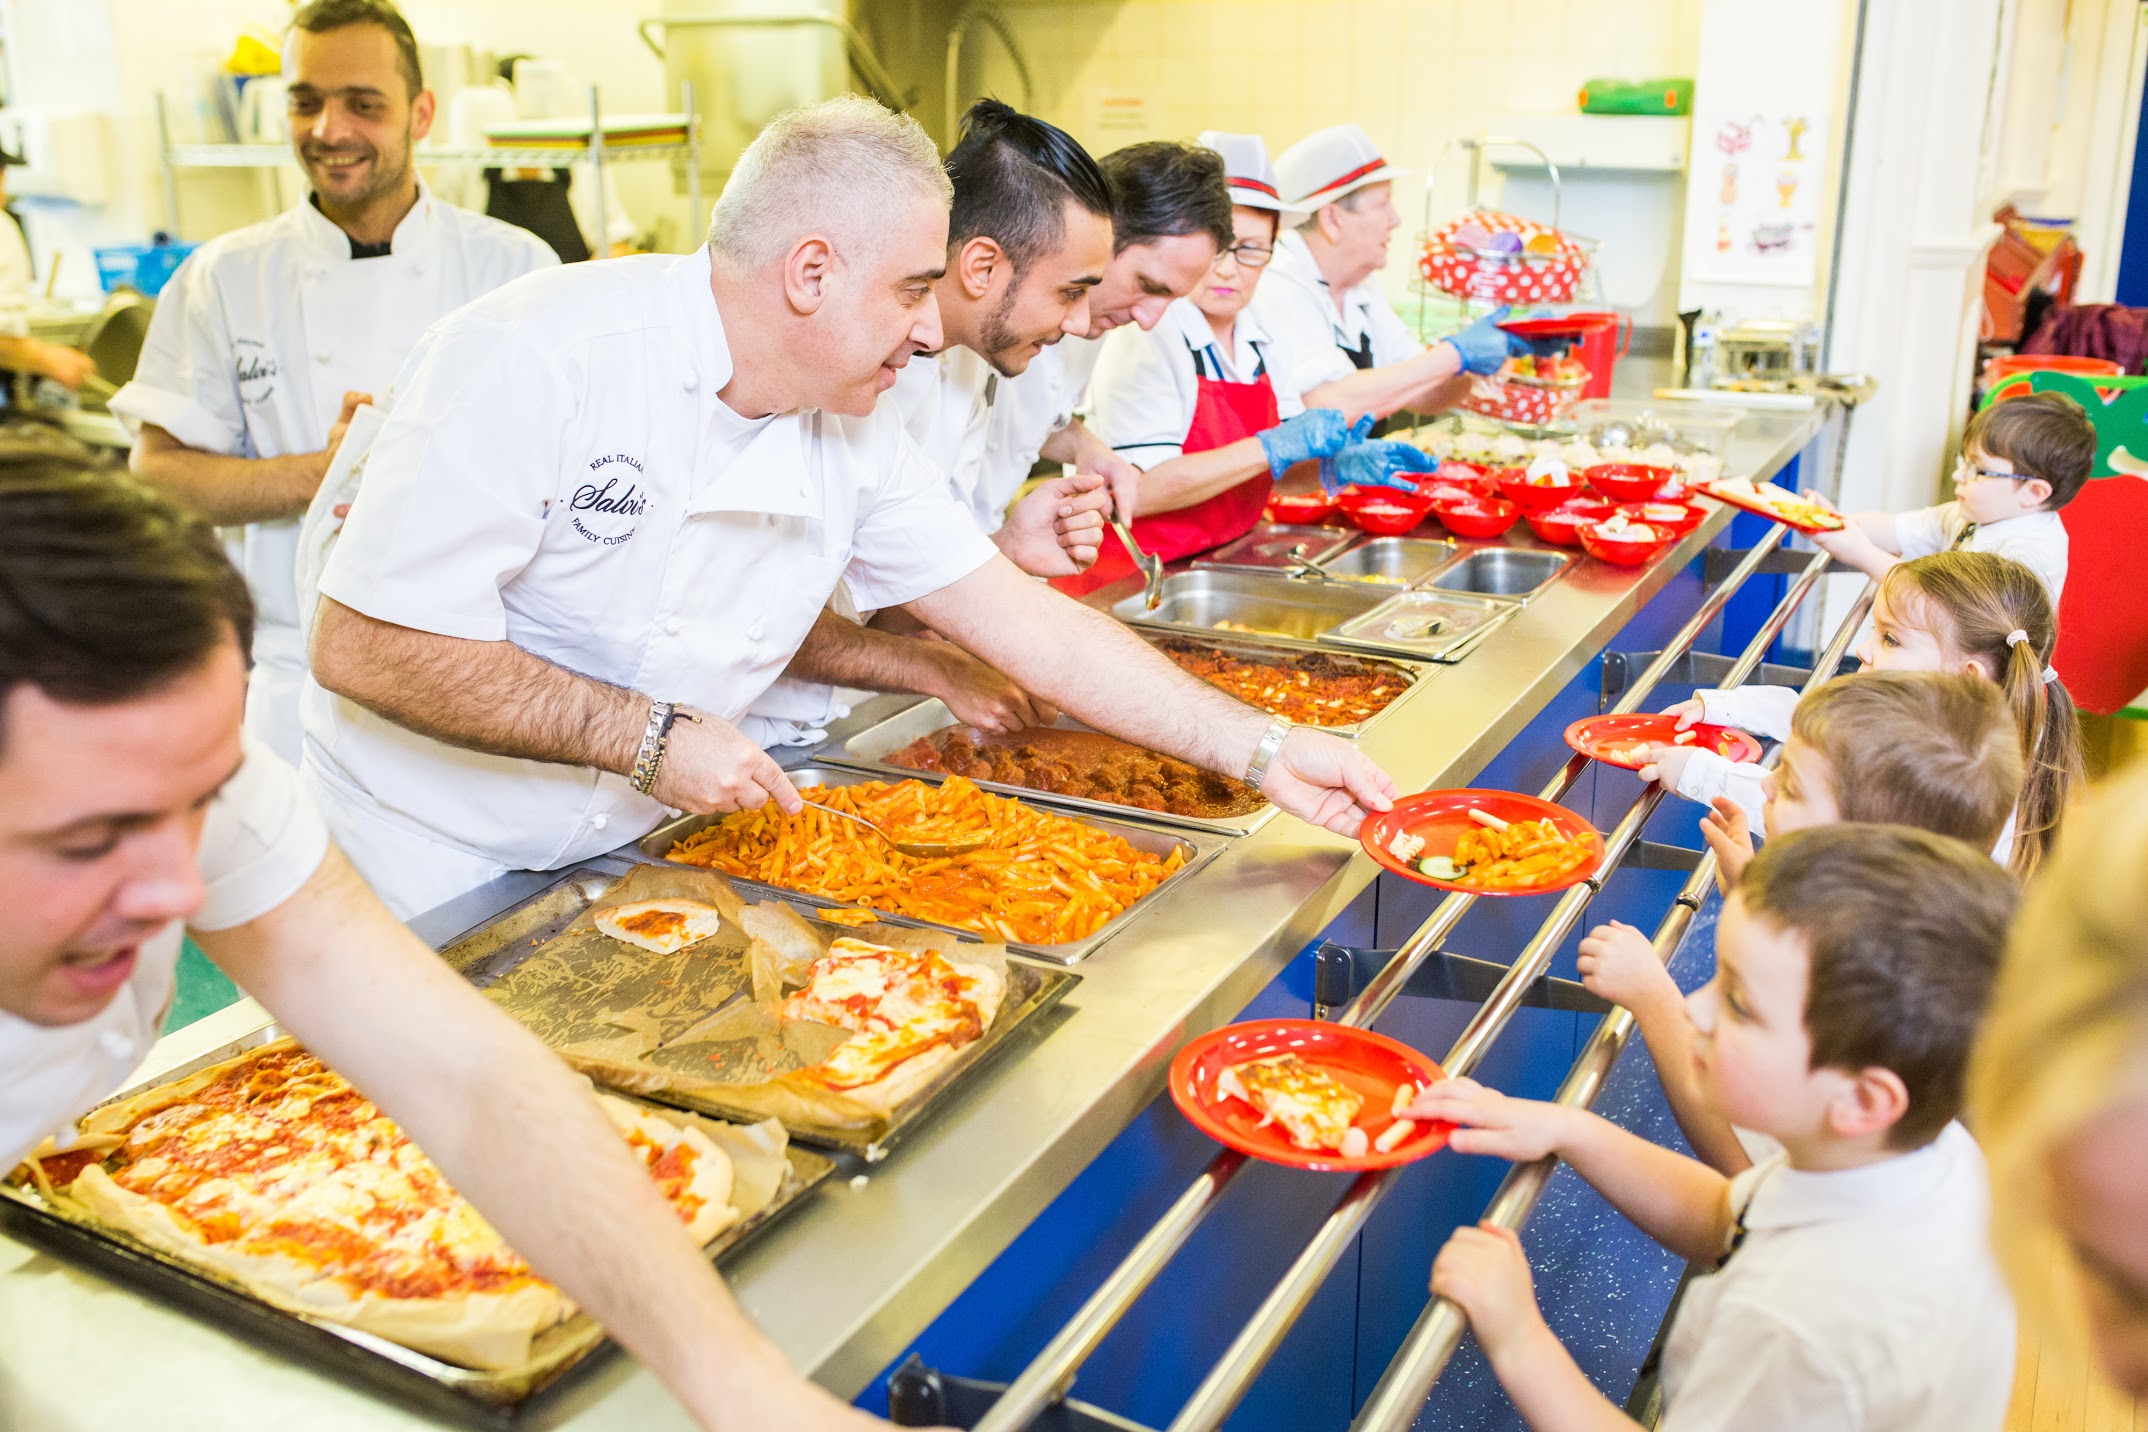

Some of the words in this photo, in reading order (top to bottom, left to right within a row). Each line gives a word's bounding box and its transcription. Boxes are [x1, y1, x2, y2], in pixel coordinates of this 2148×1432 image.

[589, 455, 614, 471] REAL
[570, 478, 646, 515] Salvi's
[571, 517, 601, 543] FAMILY
